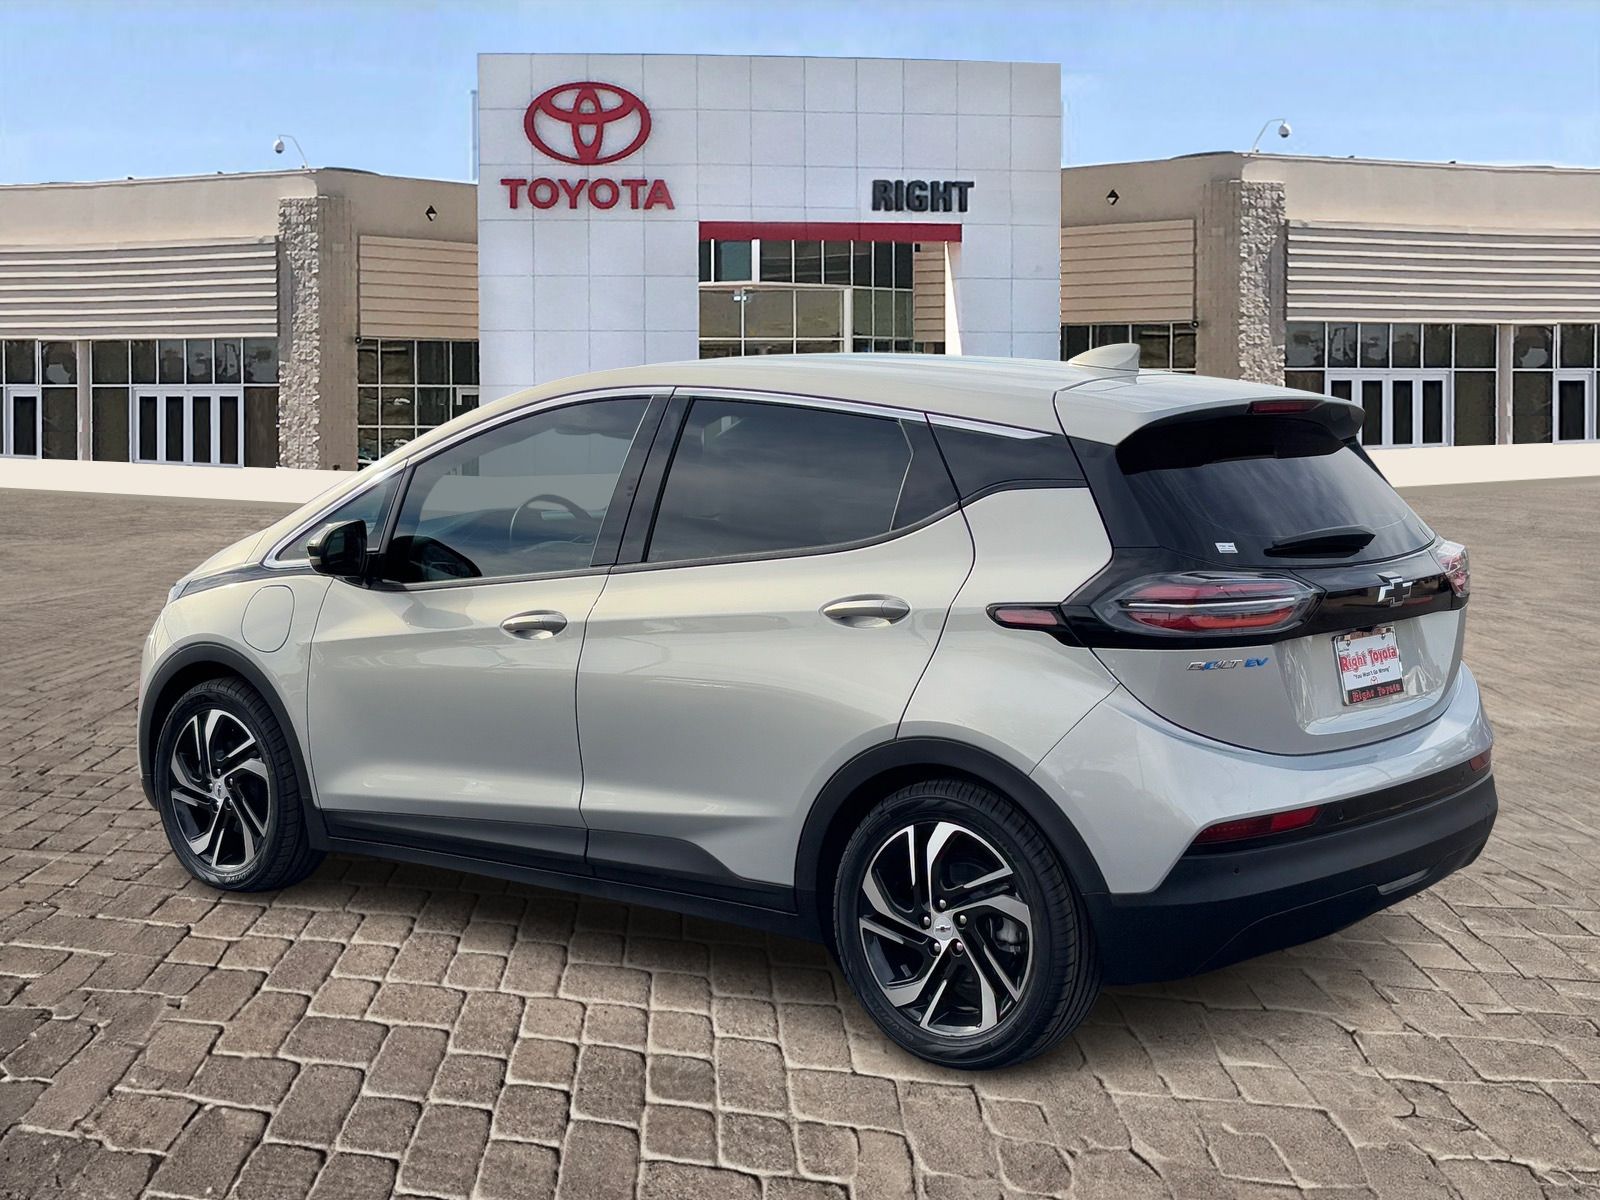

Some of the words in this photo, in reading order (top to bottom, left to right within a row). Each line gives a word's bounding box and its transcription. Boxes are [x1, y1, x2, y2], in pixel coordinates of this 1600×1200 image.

[500, 178, 675, 209] TOYOTA
[872, 180, 975, 212] RIGHT
[1187, 660, 1243, 671] BOLT
[1244, 657, 1269, 668] EV
[1340, 652, 1367, 672] Right
[1368, 646, 1397, 665] Toyota
[1352, 690, 1376, 702] Right
[1377, 684, 1400, 696] Toyota
